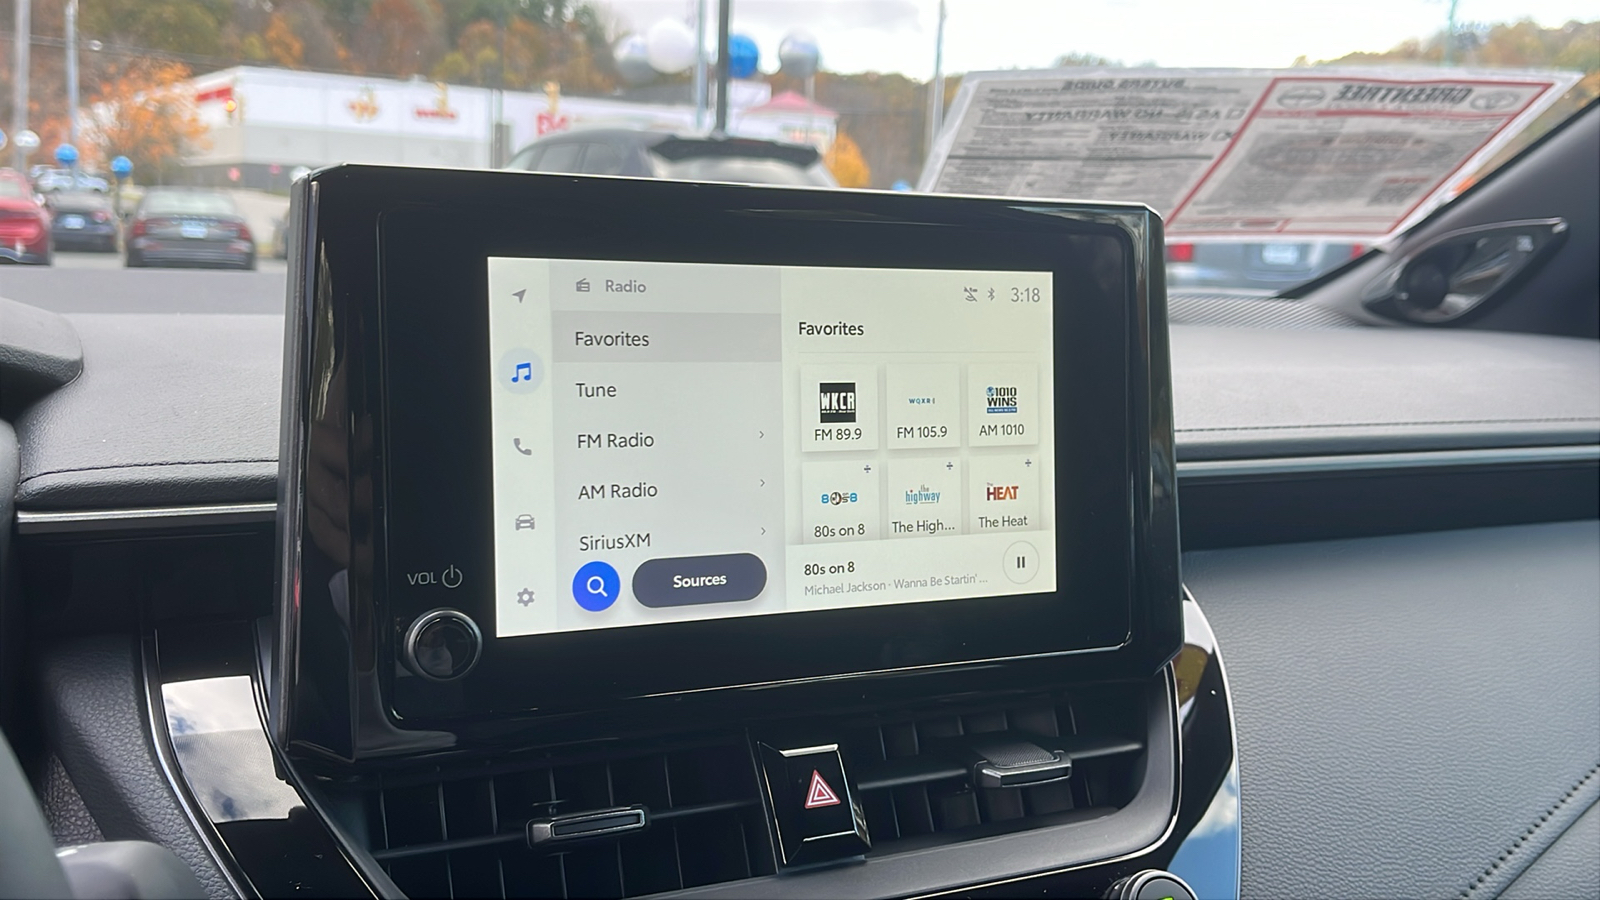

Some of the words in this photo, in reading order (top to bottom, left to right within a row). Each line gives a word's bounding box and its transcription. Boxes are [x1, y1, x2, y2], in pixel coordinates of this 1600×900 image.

[605, 279, 647, 294] Radio
[1011, 287, 1041, 303] 3:18
[799, 321, 864, 336] Favorites
[575, 331, 650, 347] Favorites
[575, 383, 617, 398] Tune
[995, 387, 1017, 397] 1010
[820, 392, 855, 410] WKCR
[987, 397, 1017, 407] WINS
[814, 429, 833, 441] FM
[836, 428, 862, 441] 89.9
[897, 427, 915, 438] FM
[917, 426, 948, 439] 105.9
[979, 425, 998, 436] AM
[1001, 424, 1025, 436] 1010
[577, 434, 602, 449] FM
[607, 432, 655, 448] Radio
[578, 485, 605, 500] AM
[611, 482, 658, 498] Radio
[905, 489, 941, 504] highway
[986, 486, 1019, 501] HEAT
[892, 521, 914, 533] The
[978, 517, 999, 528] The
[1002, 515, 1028, 528] Heat
[814, 525, 836, 538] 80s
[839, 526, 855, 536] on
[857, 523, 866, 535] 8
[579, 532, 651, 552] SiriusXM
[804, 563, 826, 576] 80s
[829, 564, 845, 574] on
[847, 561, 855, 573] 8
[407, 571, 438, 585] VOL
[672, 573, 727, 589] Sources
[804, 583, 844, 596] Michael
[847, 581, 887, 593] Jackson
[893, 579, 928, 589] Wanna
[930, 577, 943, 587] Be
